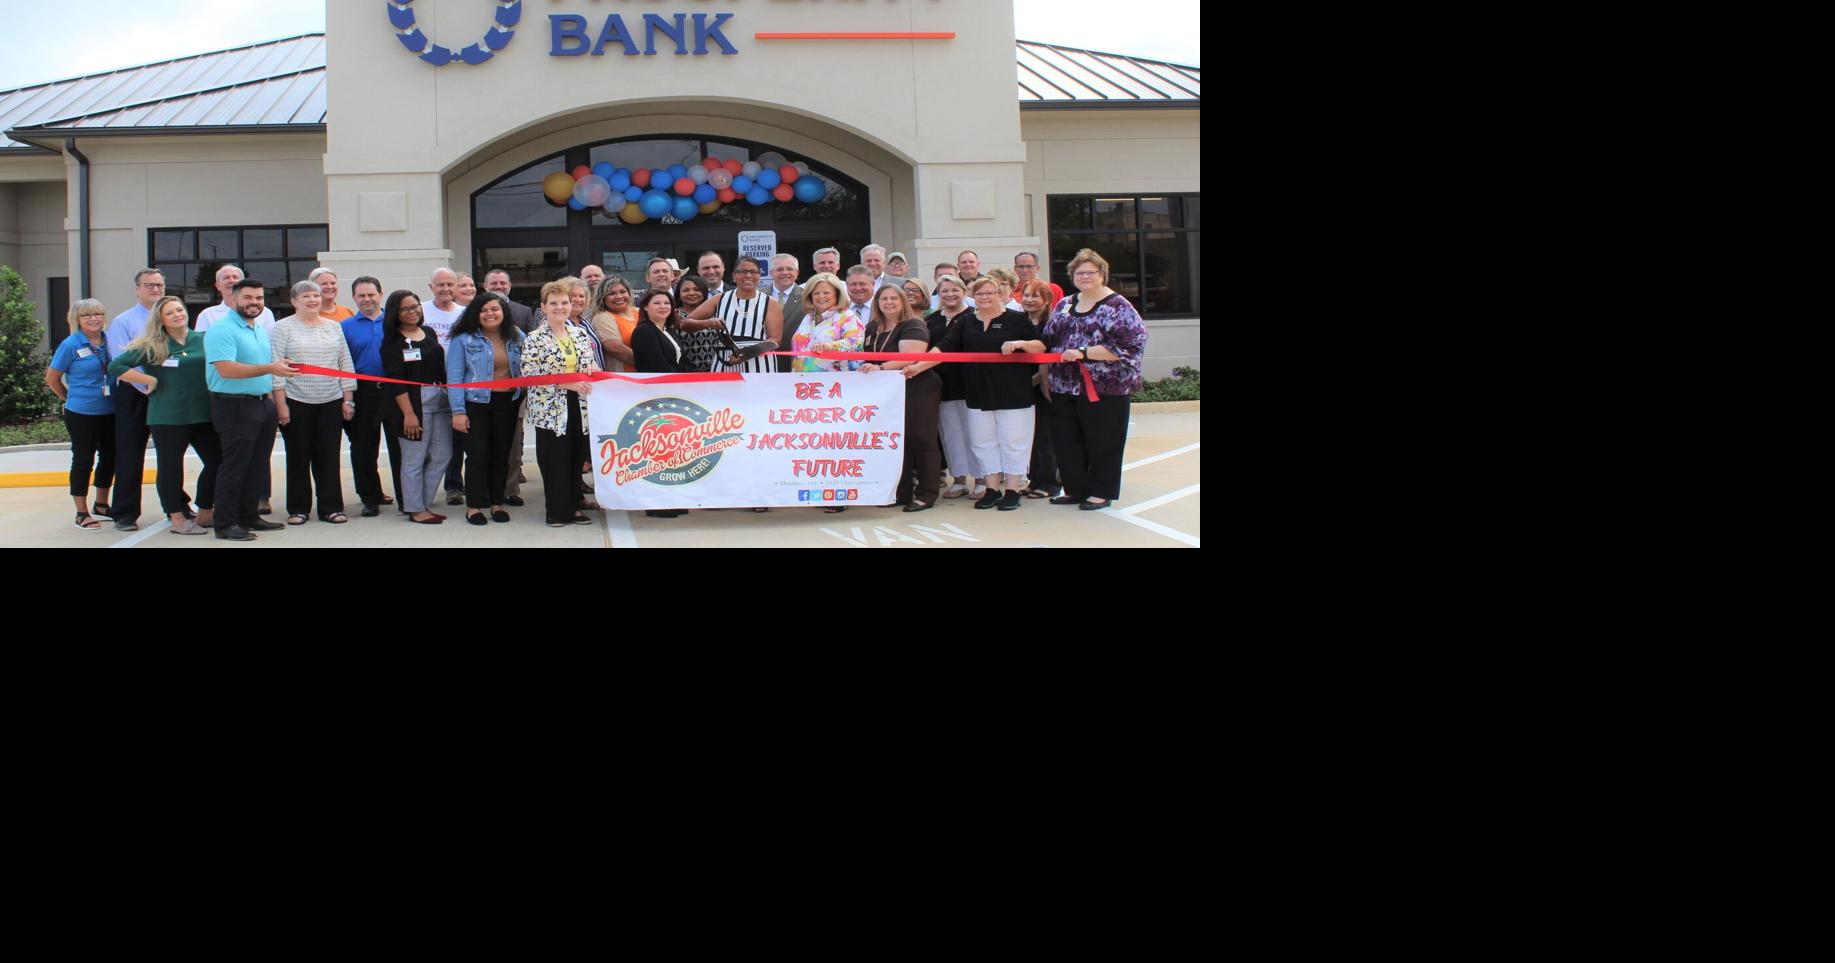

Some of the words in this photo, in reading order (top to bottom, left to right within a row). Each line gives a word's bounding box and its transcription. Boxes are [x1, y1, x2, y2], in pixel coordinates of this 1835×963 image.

[549, 13, 738, 56] BANK
[795, 382, 824, 400] BE
[828, 382, 842, 399] A
[768, 407, 847, 424] LEADER
[850, 405, 879, 423] OF
[600, 407, 745, 475] Jacksonville
[746, 431, 901, 450] JACKSONVILLE'S
[616, 460, 668, 486] Chamber
[668, 450, 681, 468] of
[681, 436, 740, 464] Commerce
[659, 472, 687, 481] GROW
[688, 458, 712, 478] HERE!
[792, 459, 865, 478] FUTURE
[818, 523, 982, 547] VAN
